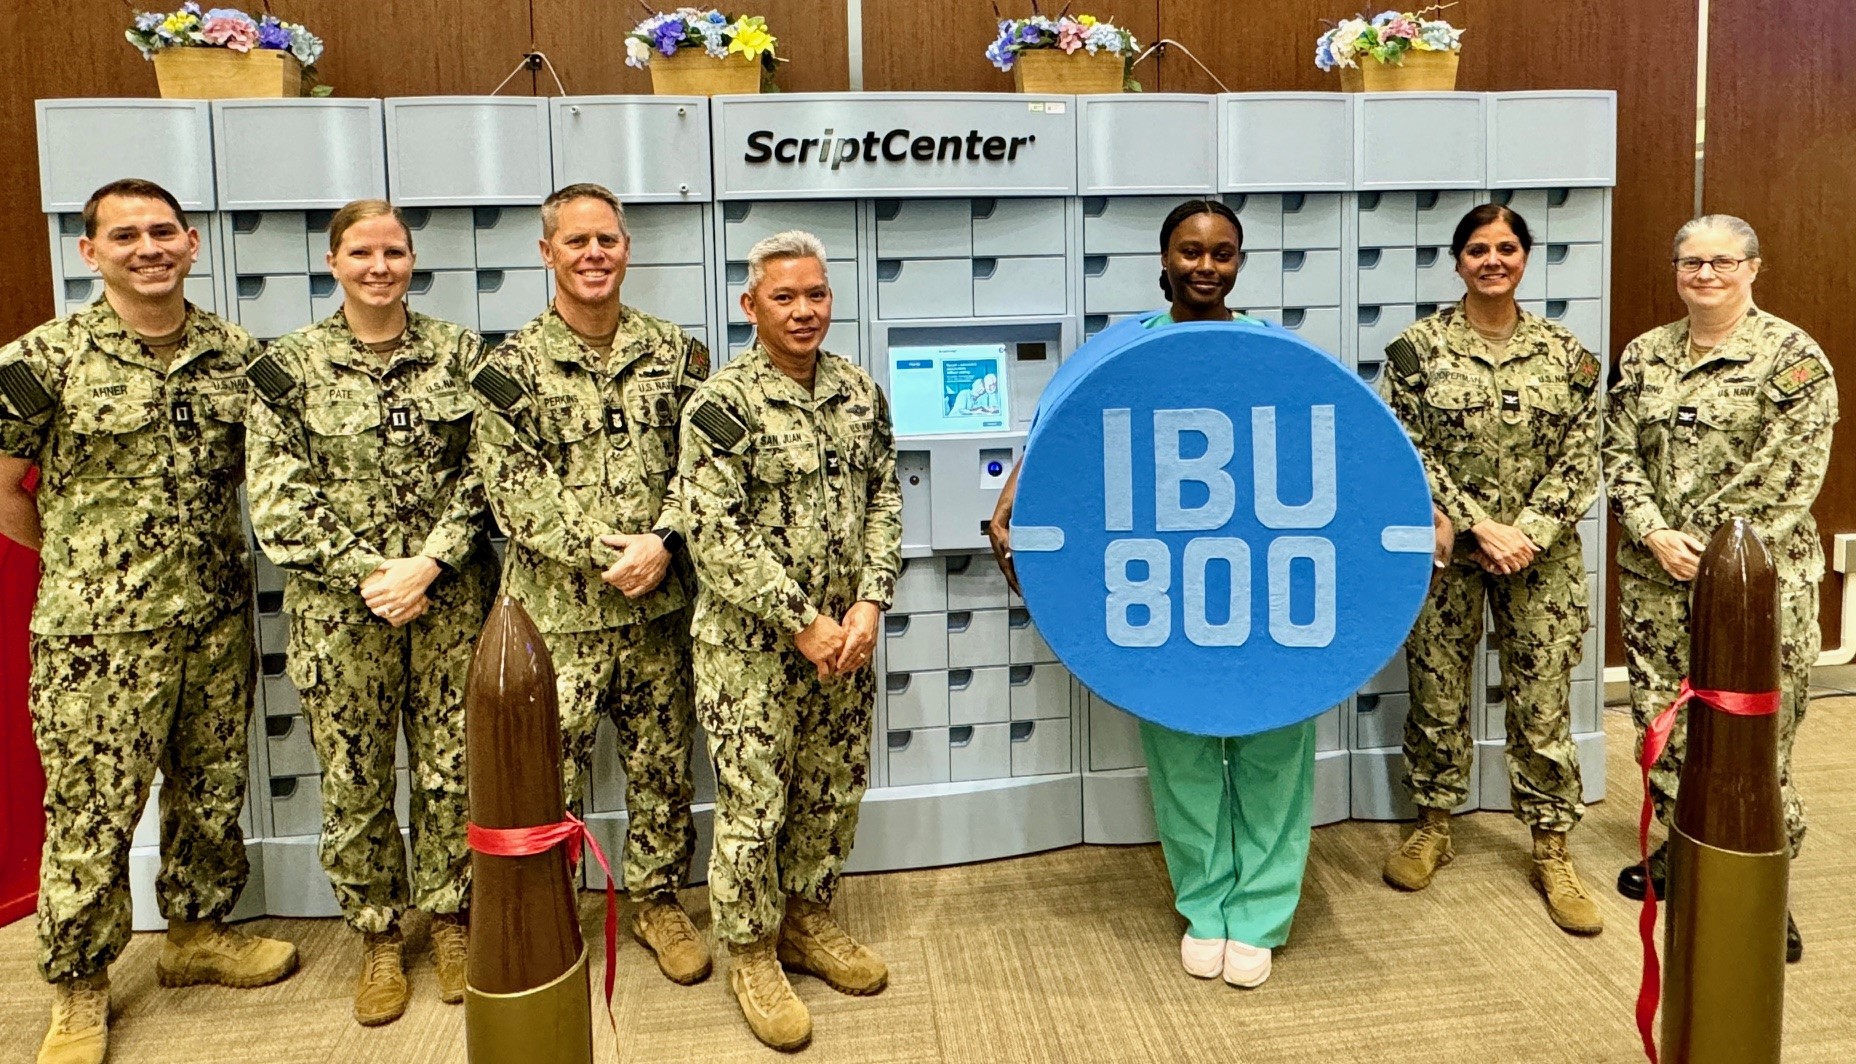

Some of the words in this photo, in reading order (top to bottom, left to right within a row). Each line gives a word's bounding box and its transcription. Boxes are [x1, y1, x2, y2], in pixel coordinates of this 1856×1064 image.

[745, 128, 1029, 171] ScriptCenter
[92, 384, 128, 399] AHNER
[329, 389, 353, 400] PATE
[1733, 387, 1756, 398] NAVY
[543, 394, 579, 408] PERKINS
[760, 434, 779, 446] SAN
[782, 432, 802, 444] JUAN
[1103, 405, 1337, 532] IBU
[1104, 536, 1336, 648] 800
